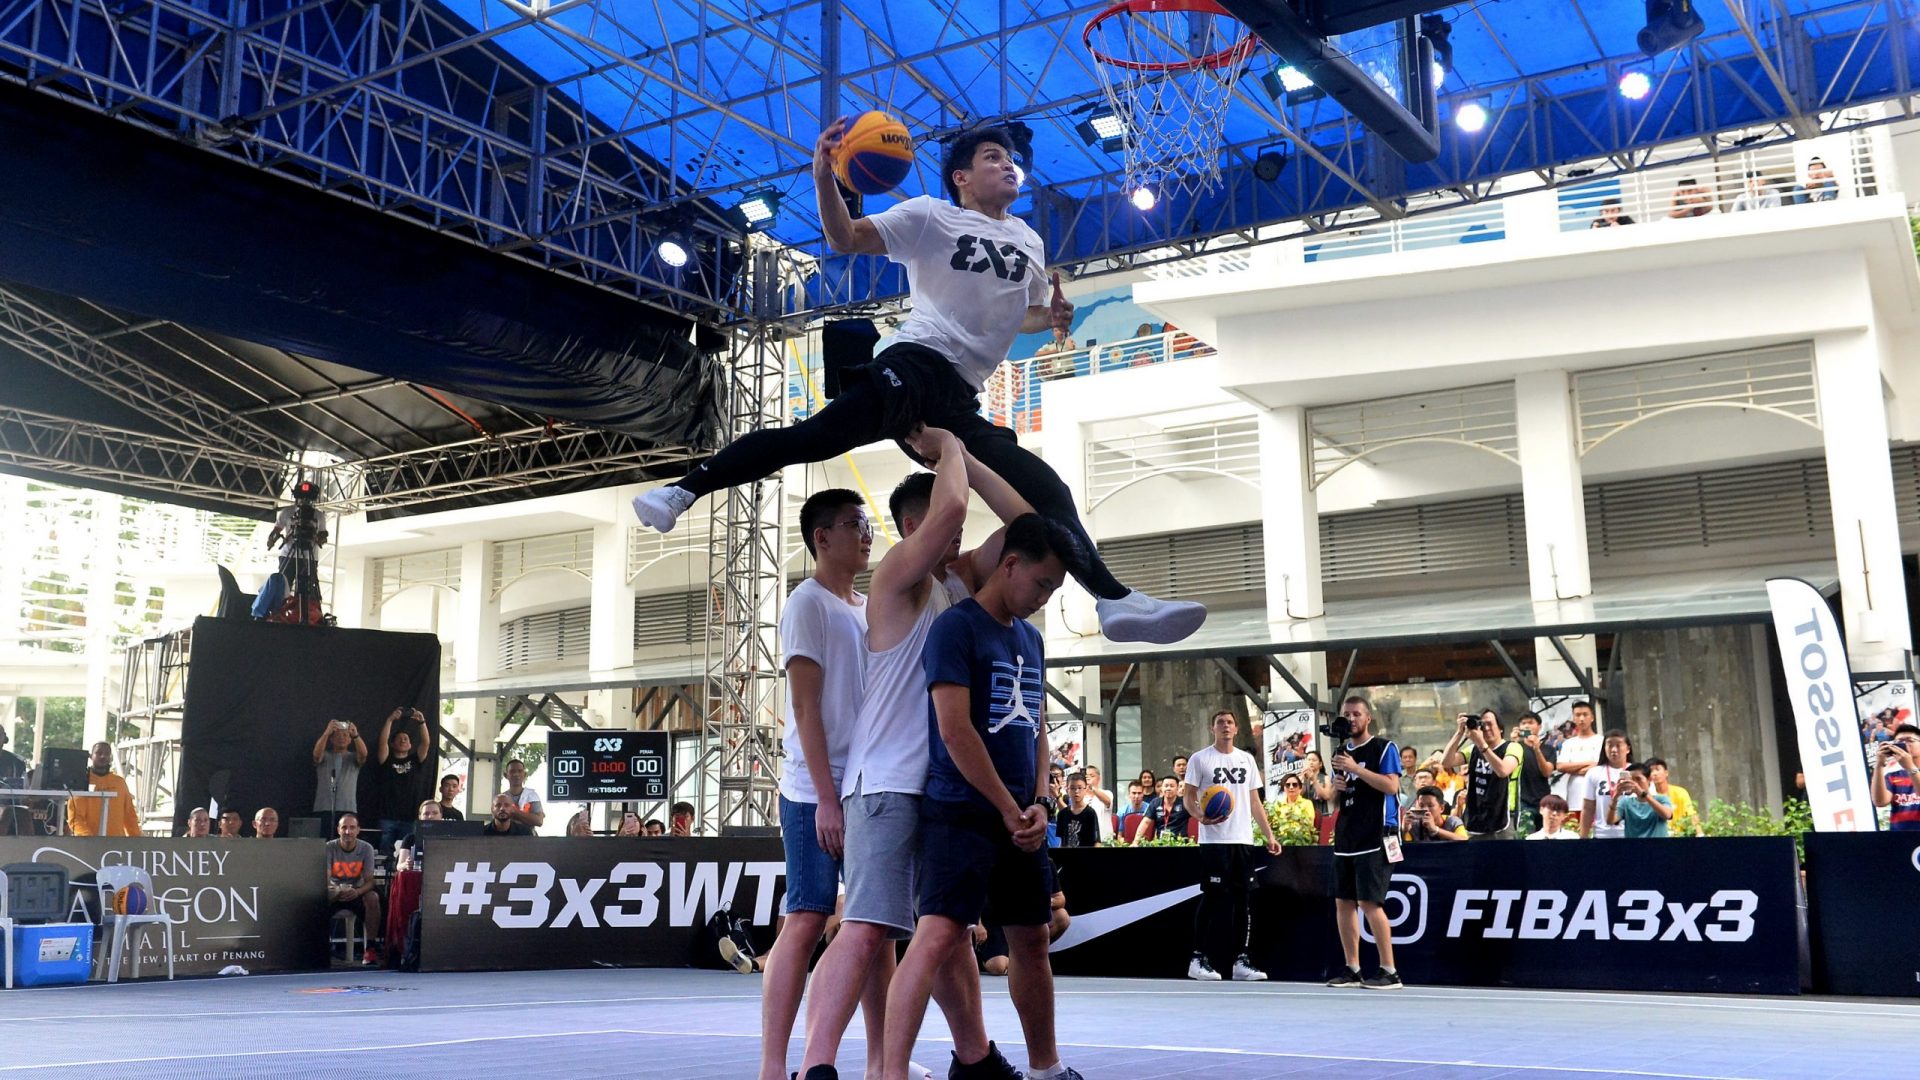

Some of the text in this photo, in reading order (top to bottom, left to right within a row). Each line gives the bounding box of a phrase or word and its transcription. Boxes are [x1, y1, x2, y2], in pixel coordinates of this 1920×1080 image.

[558, 760, 580, 774] 00
[592, 761, 626, 773] 10:00
[636, 759, 658, 773] 00
[557, 786, 564, 794] 0
[651, 785, 658, 793] 0
[67, 886, 260, 925] AGON
[1446, 889, 1759, 942] FIBA3x3
[203, 952, 218, 961] OF
